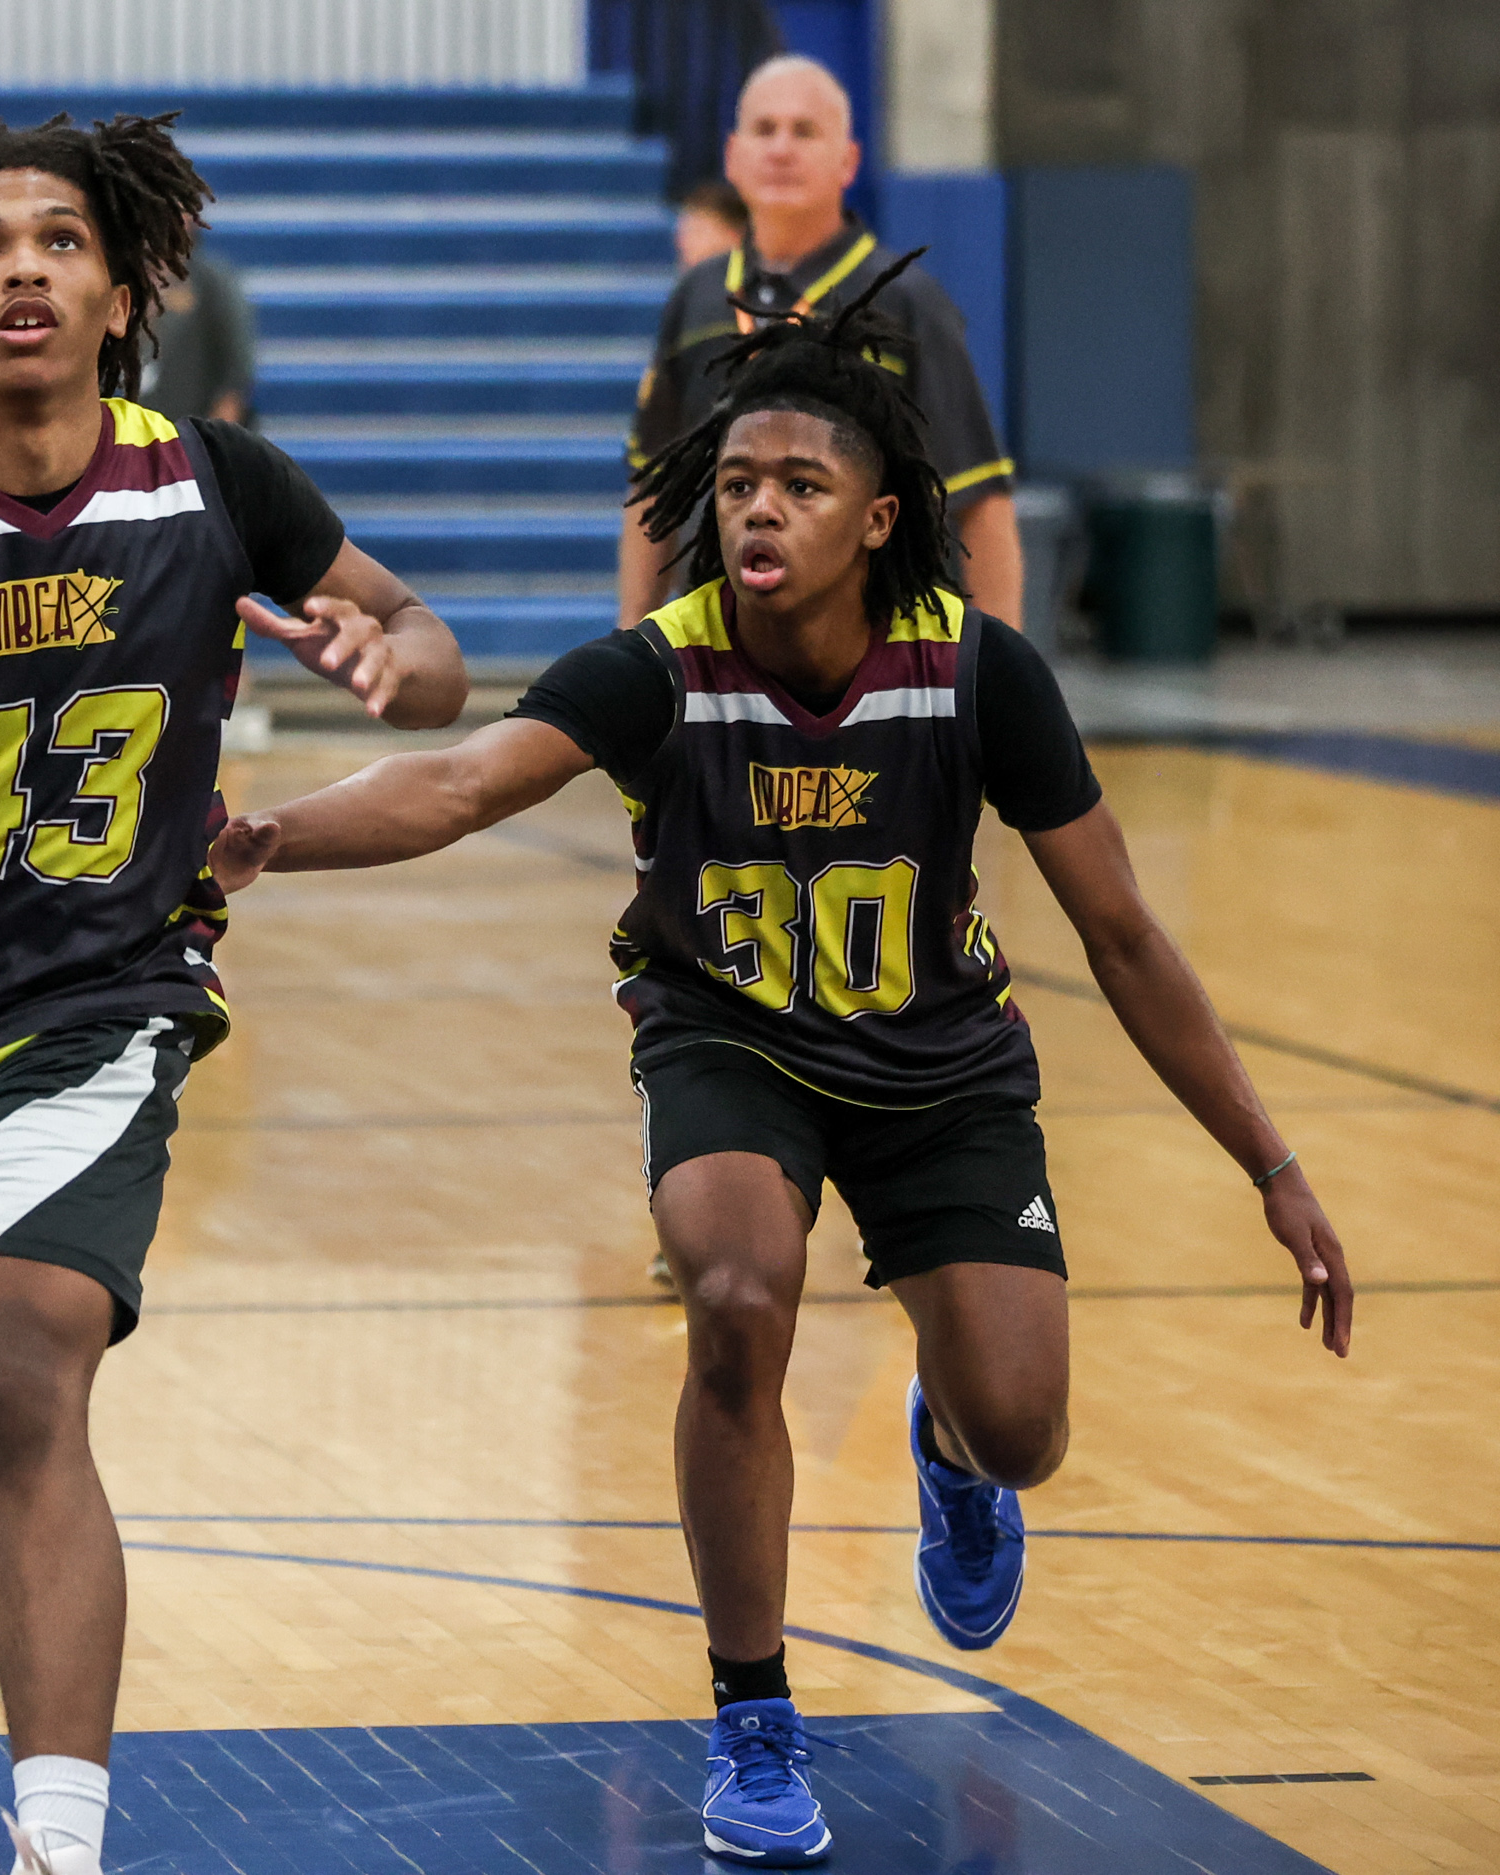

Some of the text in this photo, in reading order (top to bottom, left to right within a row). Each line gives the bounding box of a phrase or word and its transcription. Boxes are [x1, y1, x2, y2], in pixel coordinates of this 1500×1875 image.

[753, 765, 831, 827] MBCA
[697, 855, 919, 1021] 30
[1017, 1215, 1056, 1234] adidas
